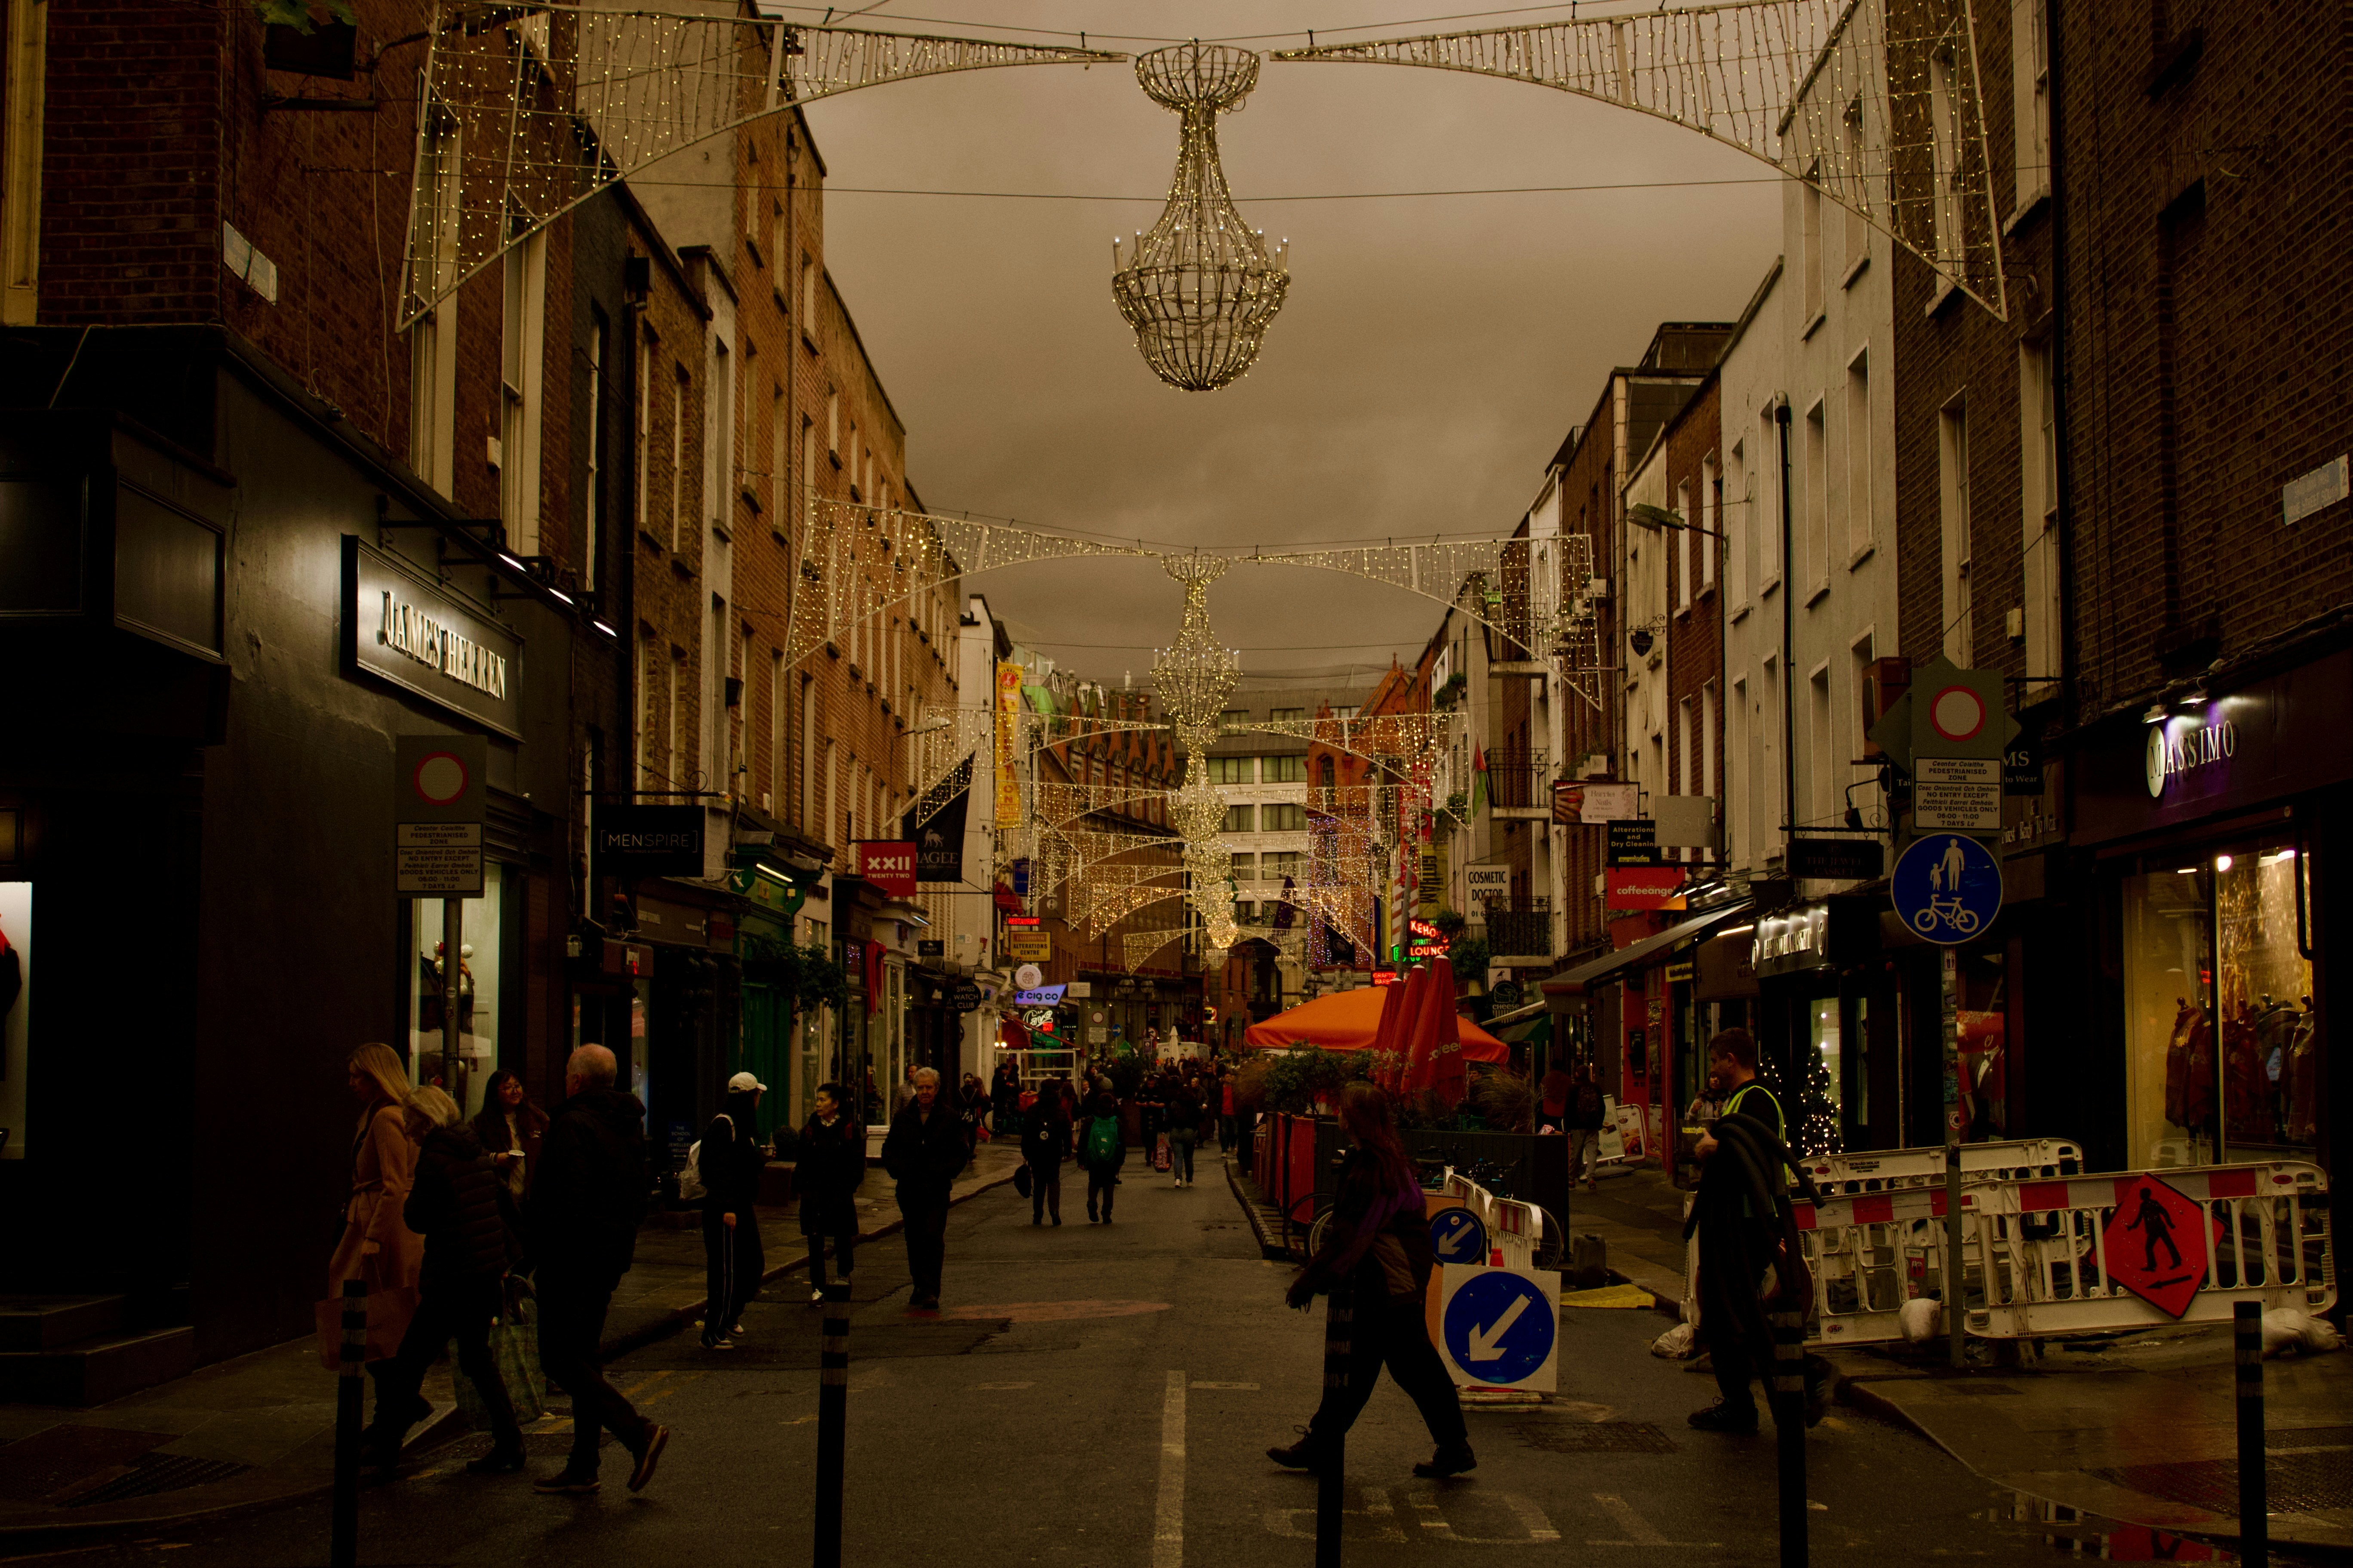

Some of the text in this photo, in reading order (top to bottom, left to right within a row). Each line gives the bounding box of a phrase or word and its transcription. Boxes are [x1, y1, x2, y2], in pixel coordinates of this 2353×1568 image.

[386, 590, 506, 701] JAMES HERREN
[2151, 720, 2233, 779] MASSIMO
[867, 856, 910, 871] XXII
[1806, 857, 1864, 866] THE JEWEL
[1468, 871, 1507, 884] COSMETIC
[1814, 867, 1855, 876] CASKET
[1026, 992, 1043, 1002] cig
